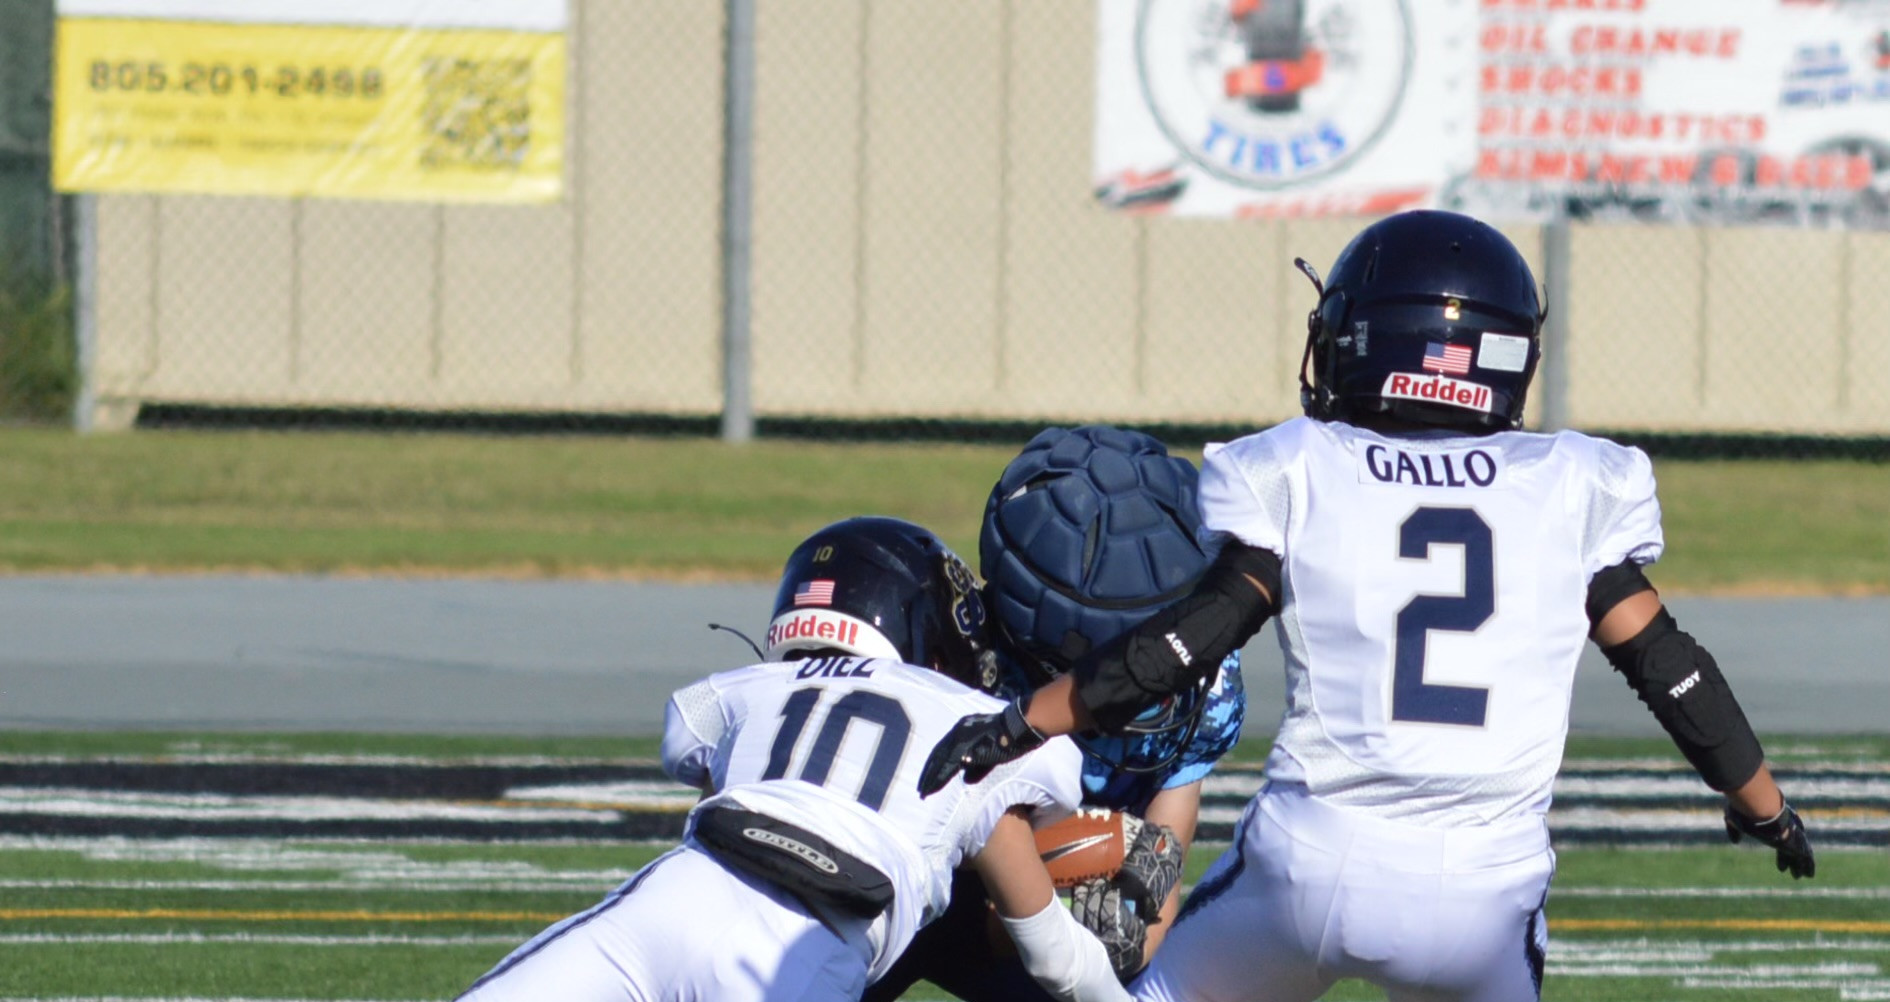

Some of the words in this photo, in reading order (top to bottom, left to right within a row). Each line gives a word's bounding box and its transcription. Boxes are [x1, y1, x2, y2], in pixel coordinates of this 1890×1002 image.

[1479, 25, 1548, 53] OIL
[1570, 27, 1740, 57] CHANGE
[1480, 65, 1643, 94] SHOCKS
[1479, 107, 1767, 141] DIAGNOSTICS
[1201, 118, 1346, 175] TIRES
[1444, 298, 1462, 320] 2
[1390, 375, 1488, 409] Riddell
[1366, 444, 1497, 488] GALLO
[812, 545, 833, 562] 10
[767, 615, 859, 652] Riddell
[1389, 503, 1499, 730] 2
[1668, 670, 1700, 698] TUOY
[761, 684, 915, 813] 10
